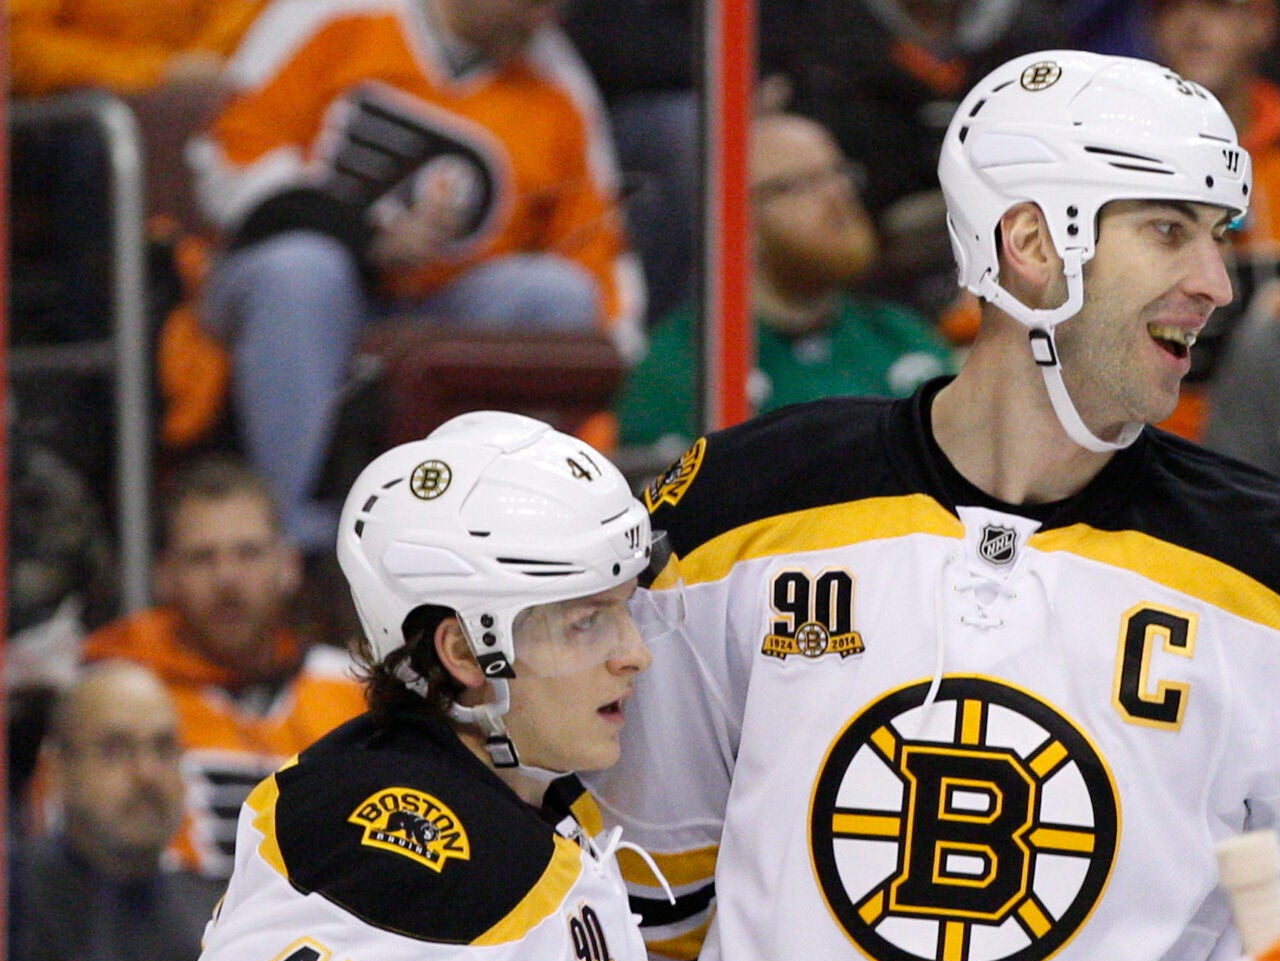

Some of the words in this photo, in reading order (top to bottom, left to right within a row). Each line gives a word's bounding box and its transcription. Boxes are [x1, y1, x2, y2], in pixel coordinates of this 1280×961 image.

[771, 568, 855, 638] 90
[1112, 602, 1196, 730] C
[356, 792, 464, 852] BOSTON
[889, 744, 1037, 923] B
